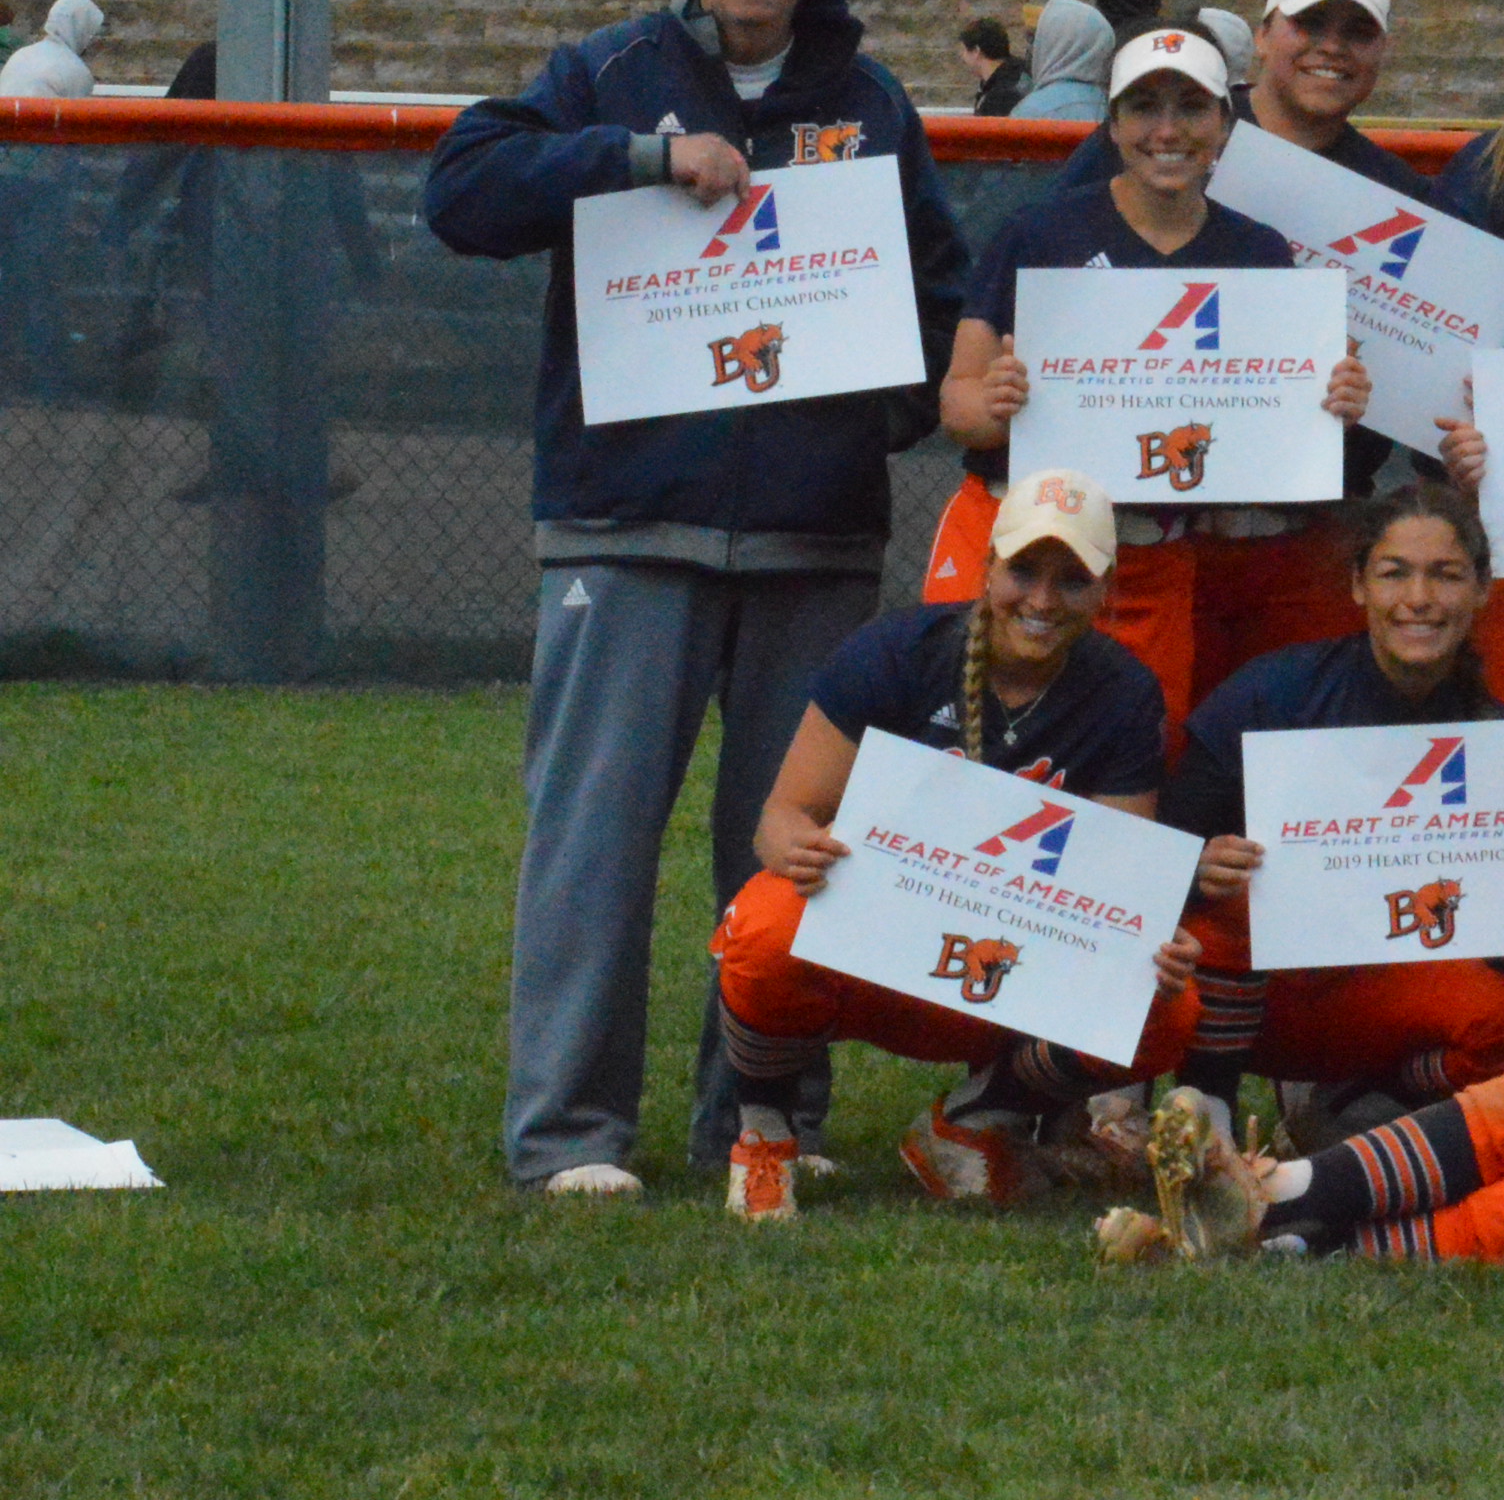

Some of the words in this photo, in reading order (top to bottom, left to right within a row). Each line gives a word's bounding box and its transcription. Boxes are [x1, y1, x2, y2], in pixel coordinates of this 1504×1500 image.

[604, 267, 701, 295] HEART
[708, 263, 736, 278] OF
[741, 246, 878, 278] AMERICA
[647, 307, 682, 323] 2019
[688, 300, 739, 318] HEART
[746, 289, 848, 309] CHAMPIONS
[1353, 275, 1481, 339] AMERICA
[1040, 357, 1138, 375] HEART
[1144, 358, 1173, 370] OF
[1177, 357, 1315, 374] AMERICA
[1079, 395, 1115, 408] 2019
[1121, 395, 1172, 408] HEART
[1179, 395, 1280, 408] CHAMPIONS
[1282, 816, 1382, 838] HEART
[1390, 815, 1419, 828] OF
[866, 825, 970, 870] HEART
[974, 861, 1005, 877] OF
[1005, 875, 1144, 931] AMERICA
[1324, 856, 1361, 870] 2019
[1368, 853, 1419, 868] HEART
[894, 875, 934, 894] 2019
[938, 888, 991, 916] HEART
[997, 909, 1097, 951] CHAMPIONS
